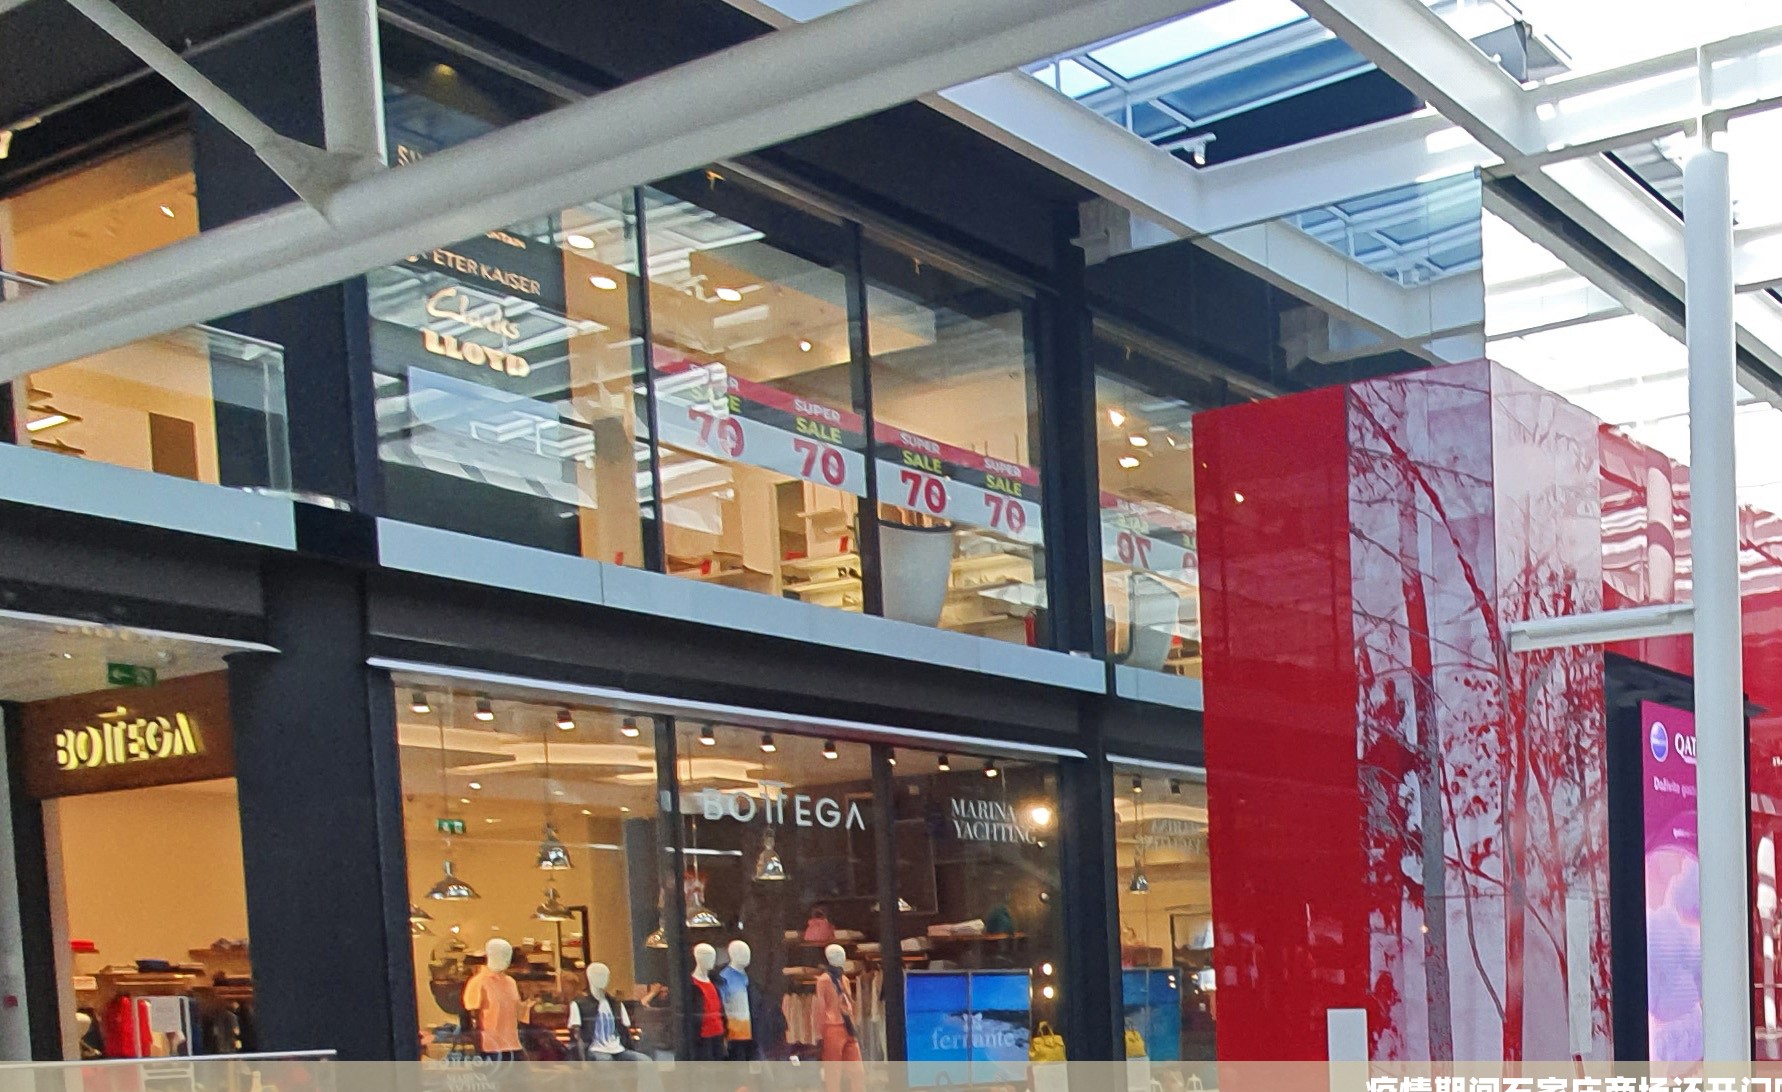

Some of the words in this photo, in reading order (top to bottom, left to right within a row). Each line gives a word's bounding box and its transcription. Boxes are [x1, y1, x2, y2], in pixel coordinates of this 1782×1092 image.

[480, 264, 541, 296] KAISER
[425, 287, 520, 340] Clarks
[421, 328, 531, 377] LLOYD
[794, 398, 841, 421] SUPER
[796, 416, 842, 444] SALE
[900, 431, 941, 455] SUPER
[794, 438, 845, 486] 70
[902, 450, 943, 474] SALE
[983, 457, 1022, 478] SUPER
[901, 470, 947, 514] 70
[985, 473, 1022, 497] SALE
[984, 492, 1026, 534] 70
[56, 705, 199, 771] BOTTEGA
[702, 779, 866, 831] BOTTEGA
[951, 798, 1018, 826] MARINA
[952, 819, 1036, 845] YACHTING
[930, 1026, 1016, 1050] ferrante
